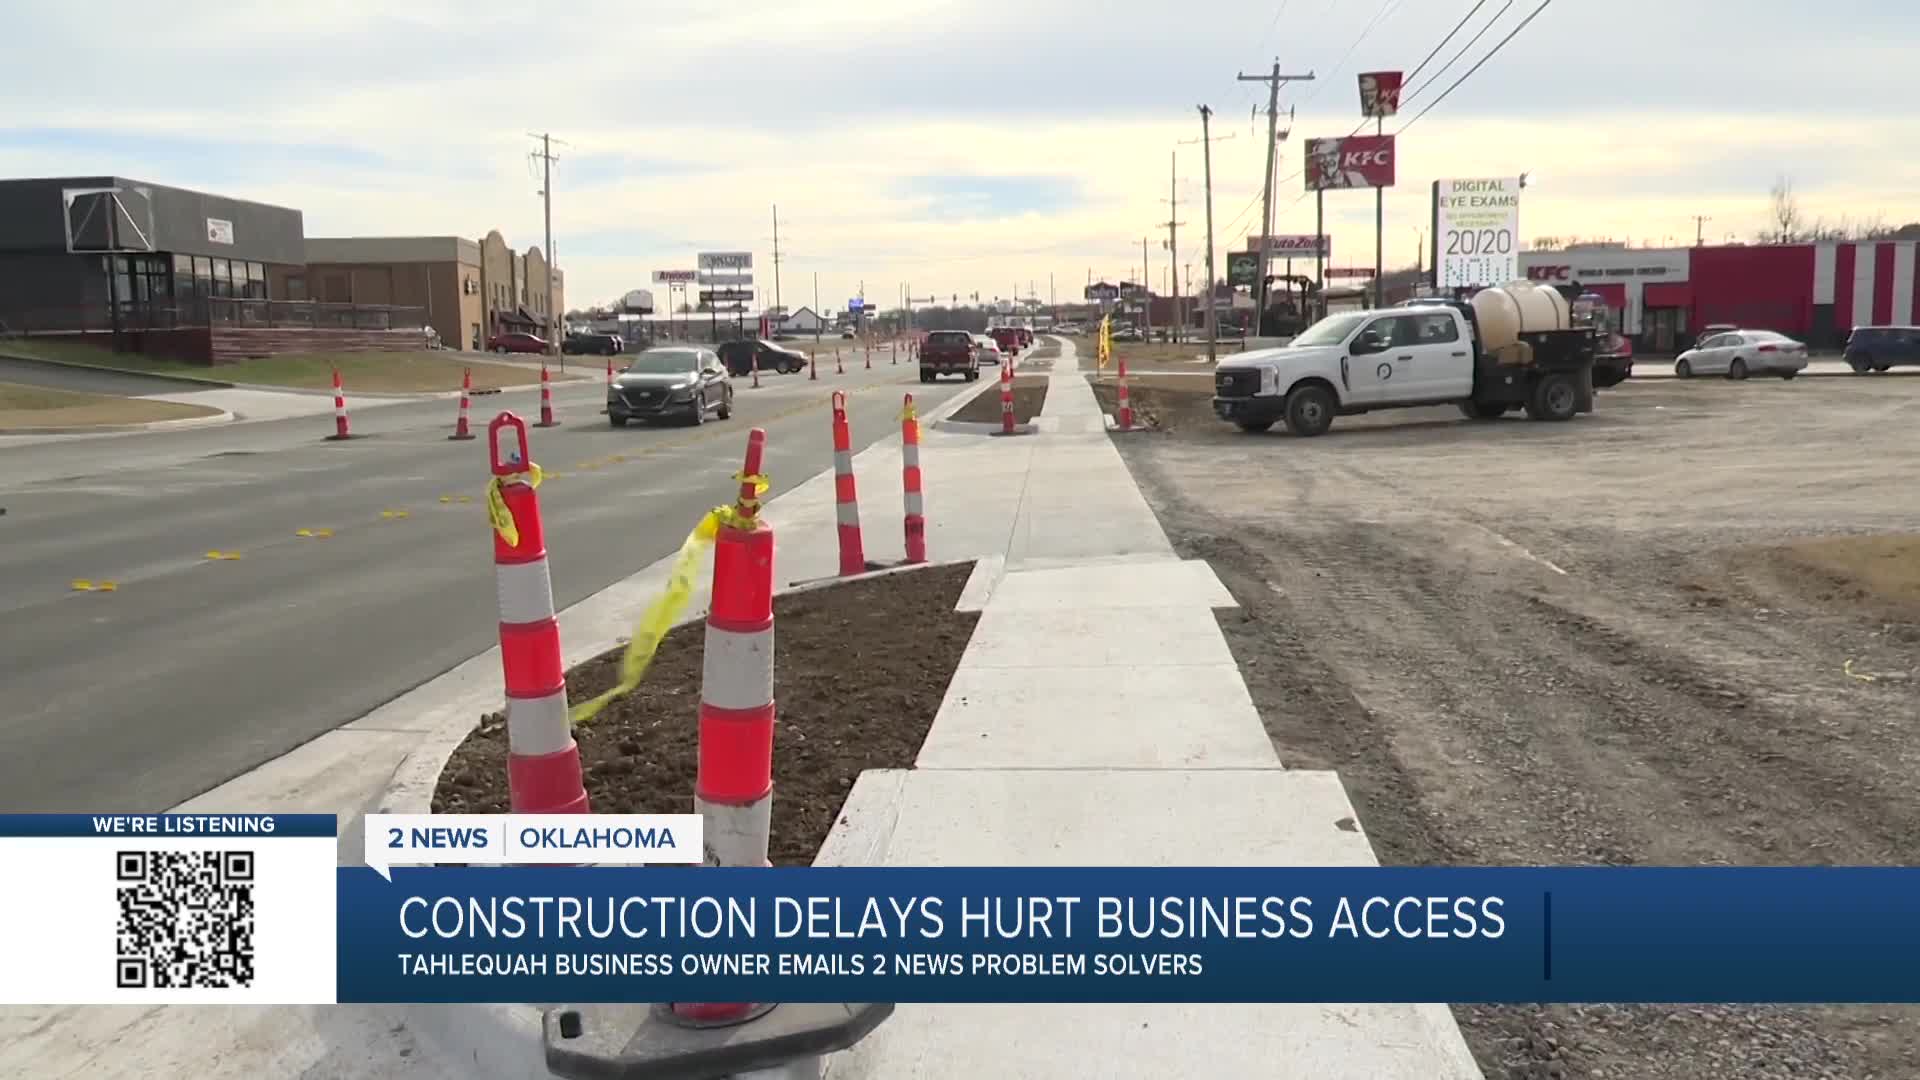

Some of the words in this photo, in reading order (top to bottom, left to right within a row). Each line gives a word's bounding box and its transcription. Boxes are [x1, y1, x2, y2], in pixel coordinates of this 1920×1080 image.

[1343, 150, 1389, 167] KFC
[1453, 180, 1505, 193] DIGITAL
[1440, 196, 1467, 208] EYE
[1470, 195, 1519, 208] EXAMS
[1266, 237, 1325, 249] utoZon
[1447, 228, 1512, 256] 20/20
[1527, 266, 1571, 281] KFC
